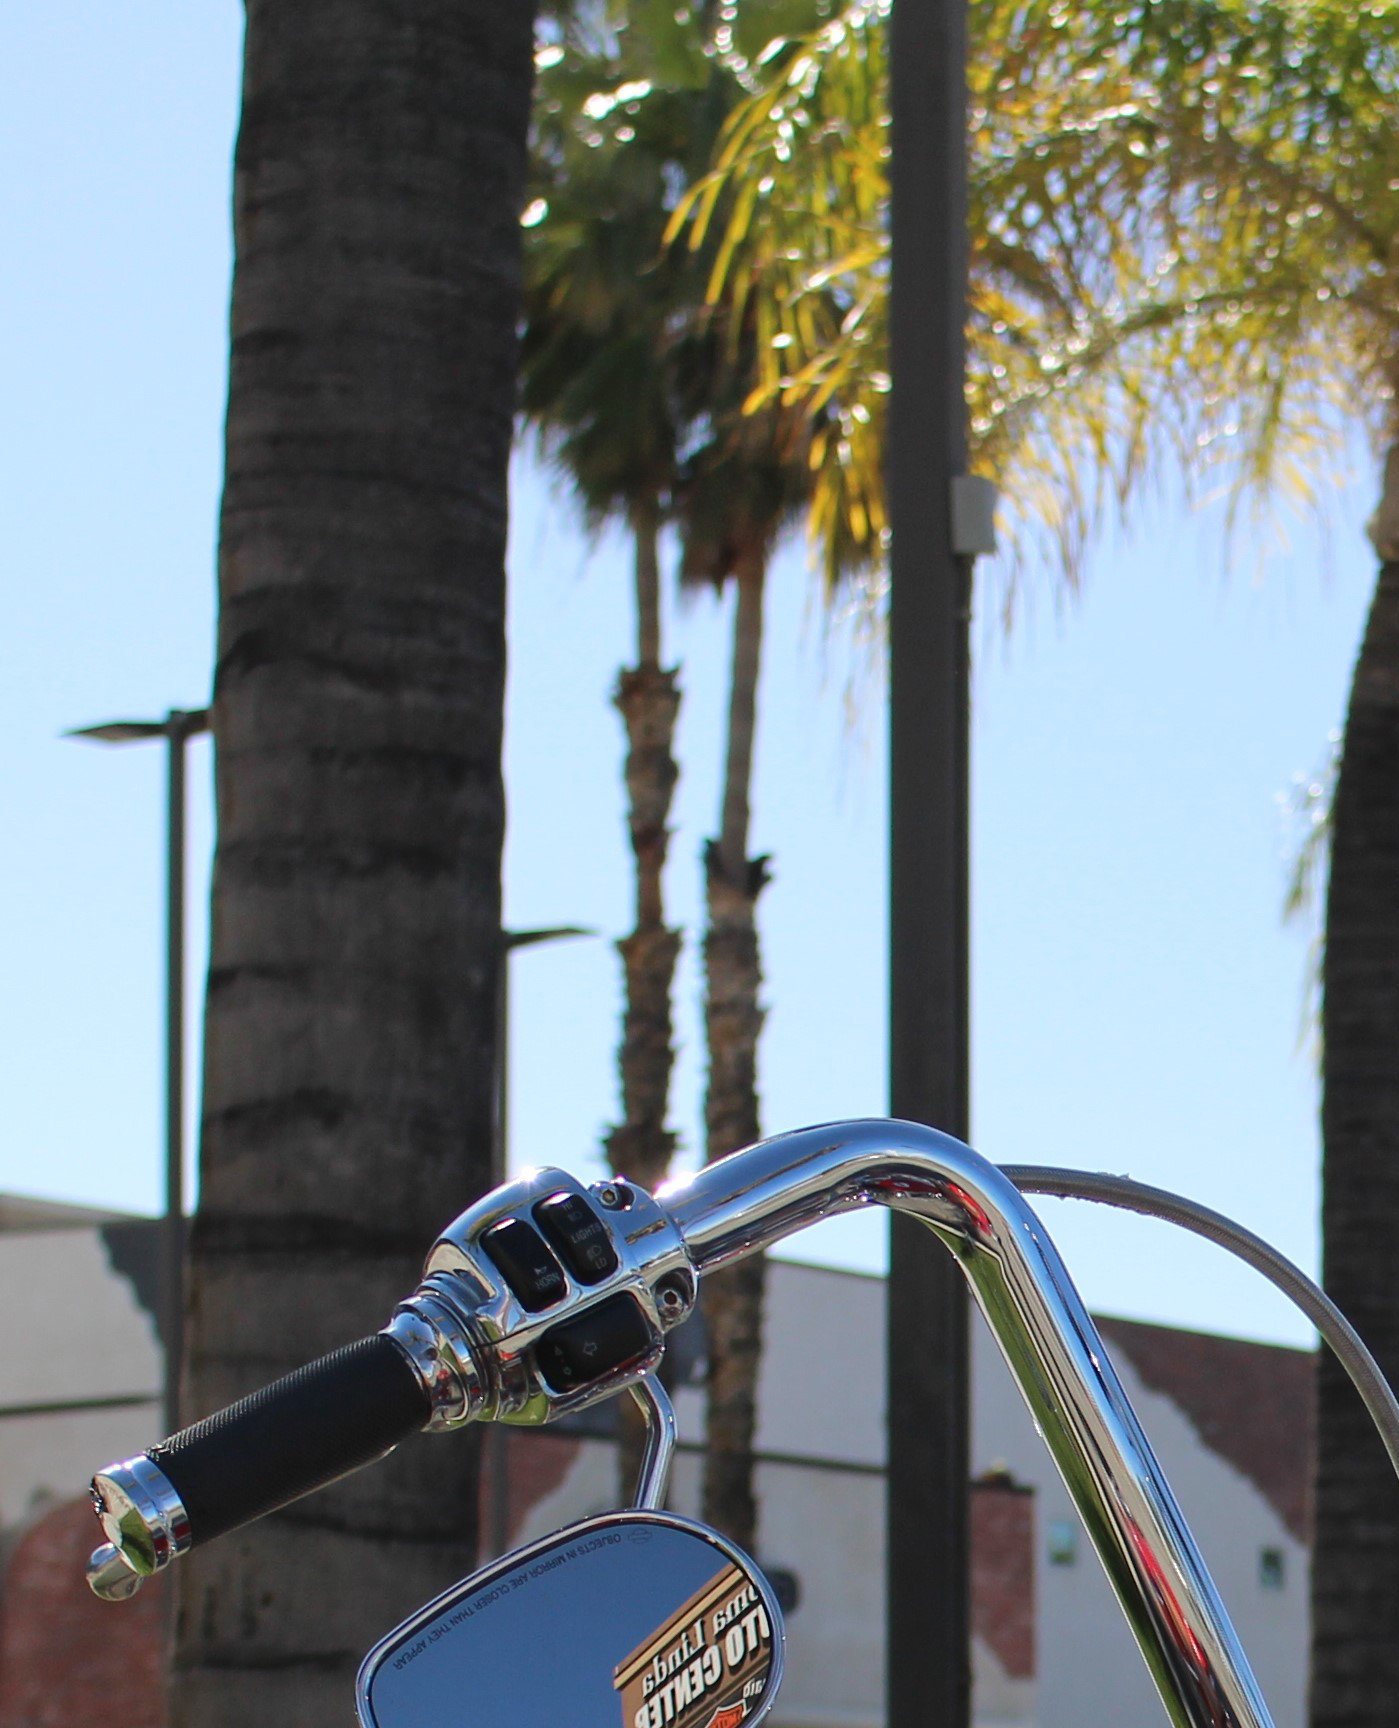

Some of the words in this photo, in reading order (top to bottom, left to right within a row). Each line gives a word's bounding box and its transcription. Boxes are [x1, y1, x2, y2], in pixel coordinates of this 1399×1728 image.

[569, 1222, 602, 1244] LIGHTS
[595, 1257, 608, 1270] LO
[535, 1271, 561, 1291] HORN
[565, 1548, 578, 1562] IN
[577, 1533, 621, 1555] OBJECTS
[529, 1554, 567, 1580] MIRROR
[510, 1573, 529, 1588] ARE
[474, 1584, 511, 1612] CLOSER
[450, 1605, 476, 1628] THAN
[427, 1622, 451, 1645] THEY
[392, 1638, 429, 1671] APPEAR
